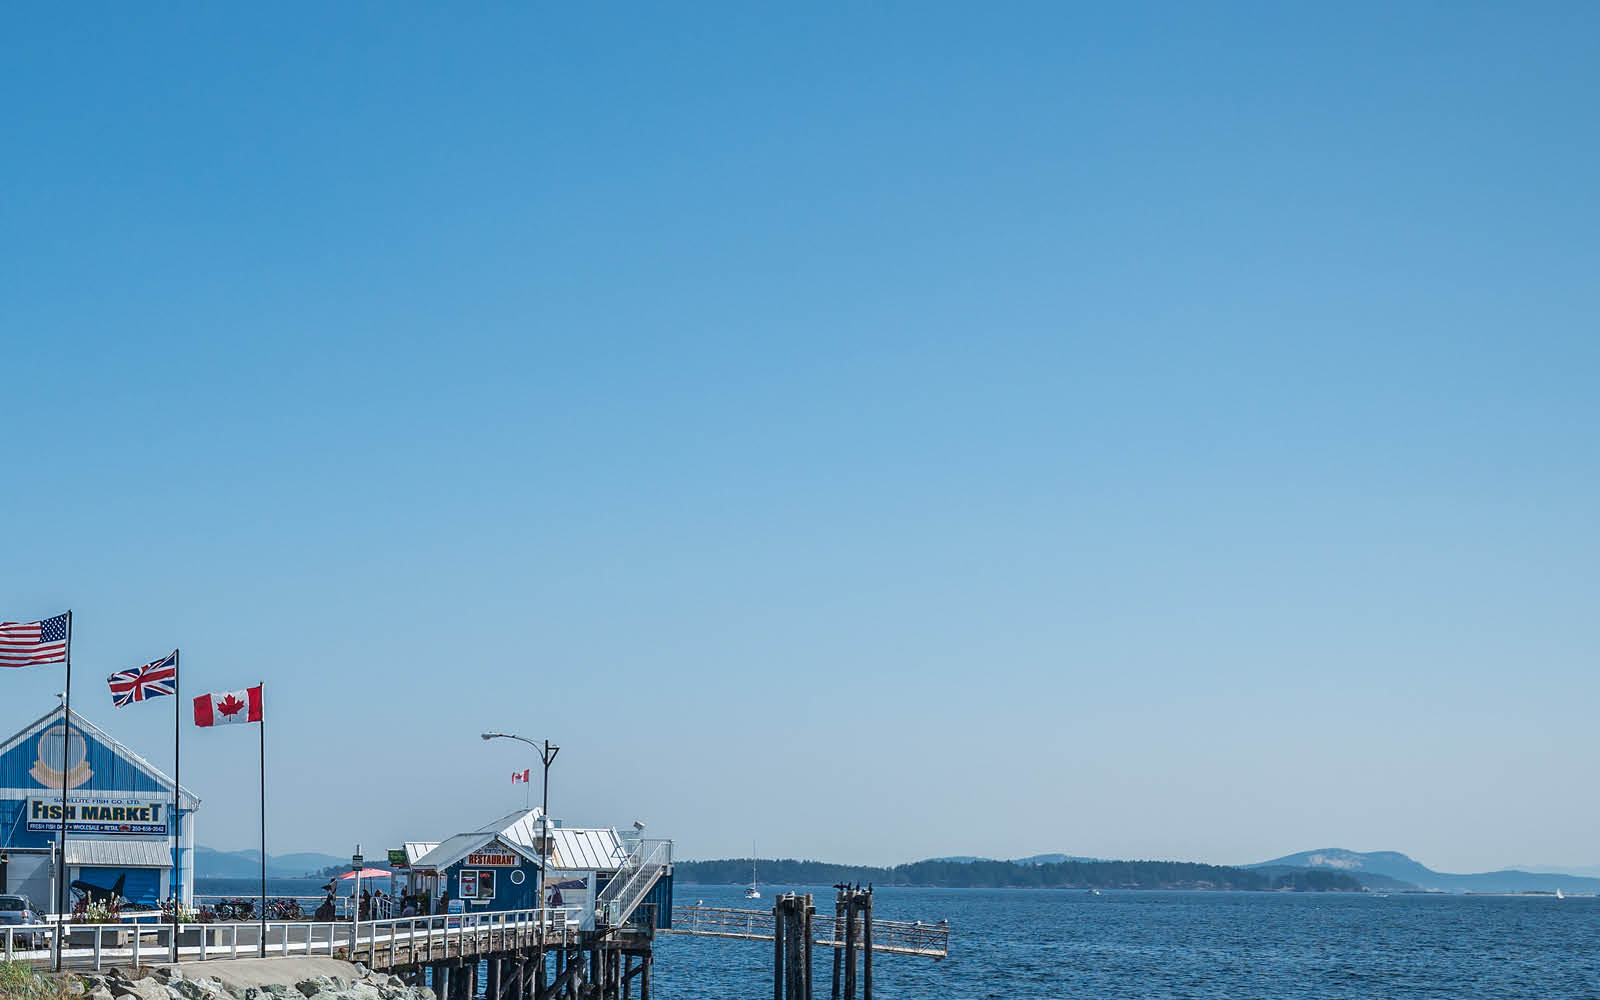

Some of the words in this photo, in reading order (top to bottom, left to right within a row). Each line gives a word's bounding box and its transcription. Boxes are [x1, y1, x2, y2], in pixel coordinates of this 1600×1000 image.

[32, 800, 76, 820] FISH
[81, 803, 163, 822] MARKET
[469, 855, 516, 865] RESTAURANT
